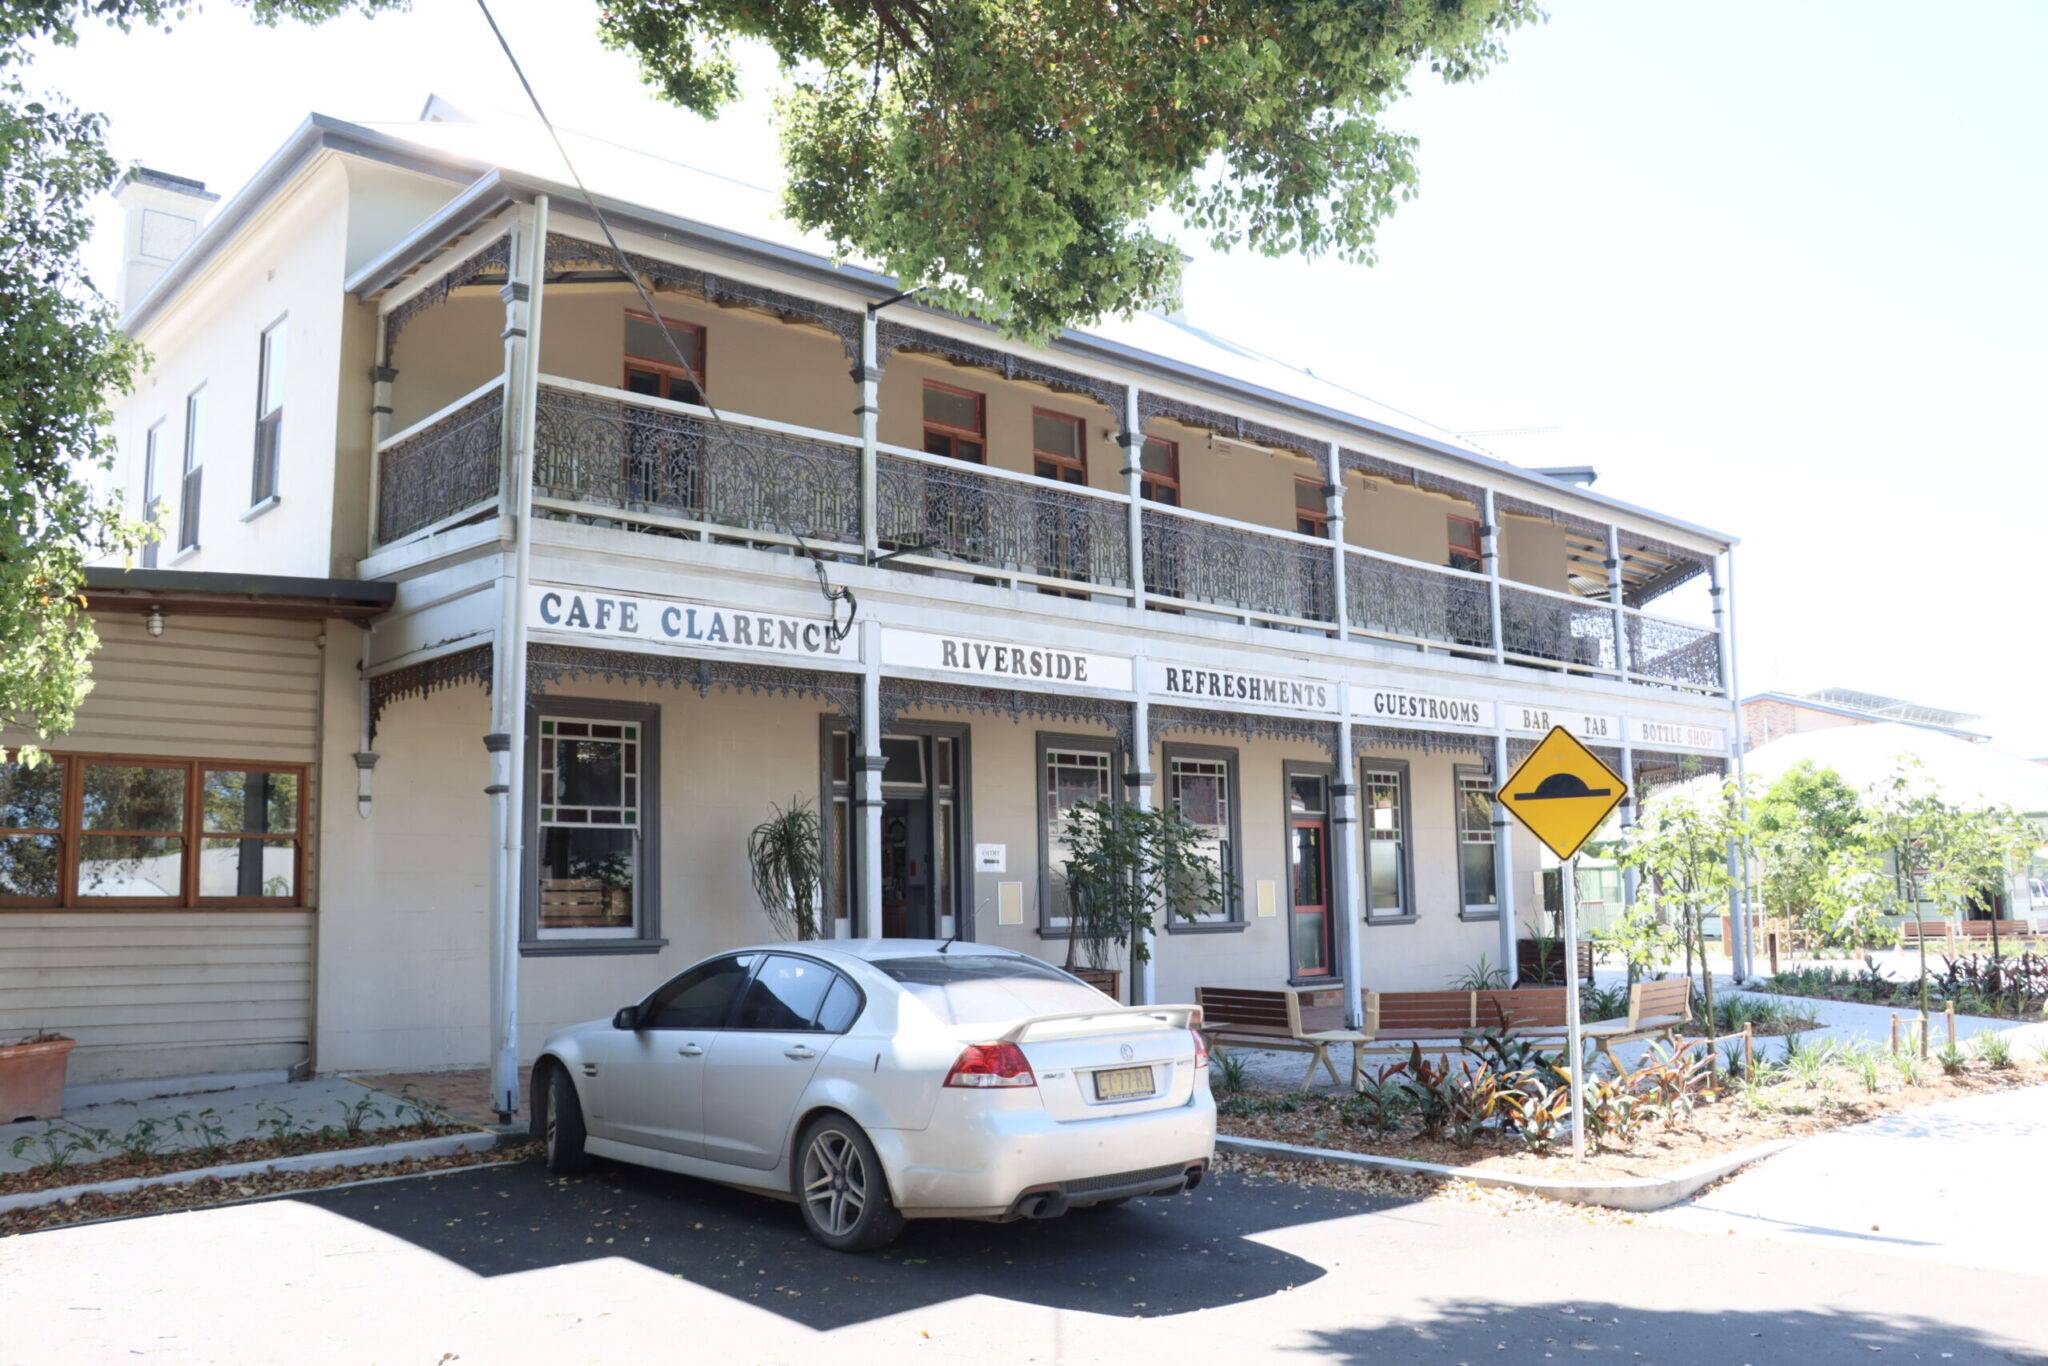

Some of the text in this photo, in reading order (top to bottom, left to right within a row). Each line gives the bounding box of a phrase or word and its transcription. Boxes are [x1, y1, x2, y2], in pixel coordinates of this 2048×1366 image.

[540, 592, 841, 655] CAFE CLARENCE
[942, 639, 1088, 681] RIVERSIDE
[1166, 667, 1327, 707] REFRESHMENTS
[1374, 692, 1479, 722] GUESTROOMS
[1523, 709, 1608, 736] BAR TAB
[1642, 723, 1712, 747] BOTTLE SHOP
